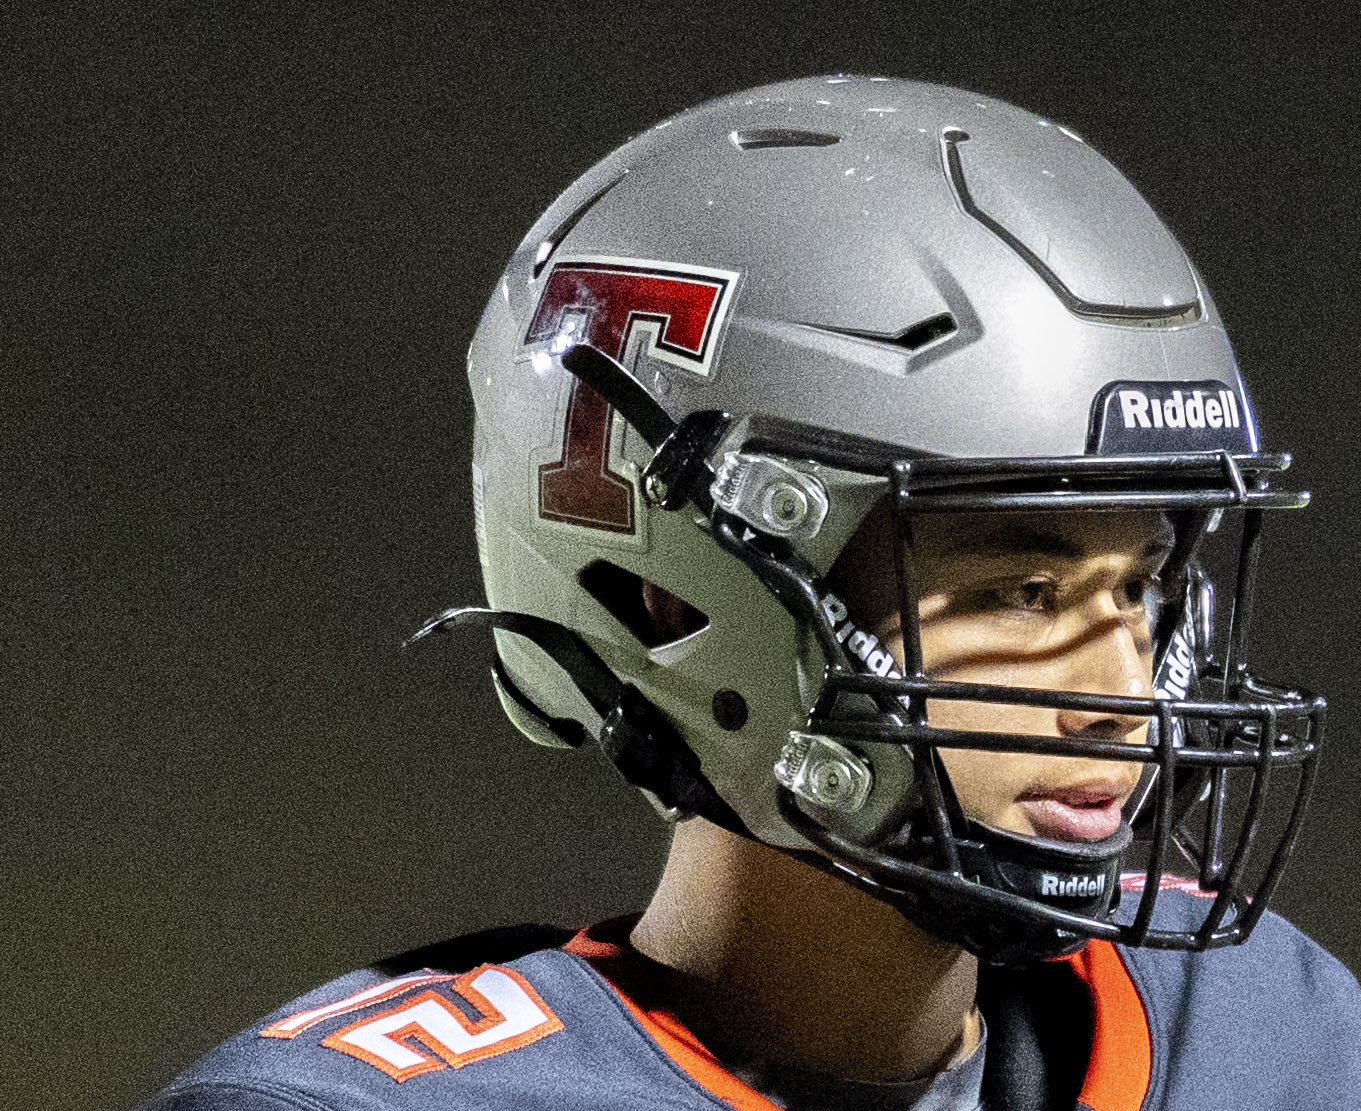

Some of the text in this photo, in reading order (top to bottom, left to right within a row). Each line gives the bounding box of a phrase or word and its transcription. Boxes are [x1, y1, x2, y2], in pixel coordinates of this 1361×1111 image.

[521, 255, 741, 538] T
[1118, 390, 1240, 429] Riddell
[821, 593, 911, 709] Ridd
[1041, 873, 1106, 896] Riddell
